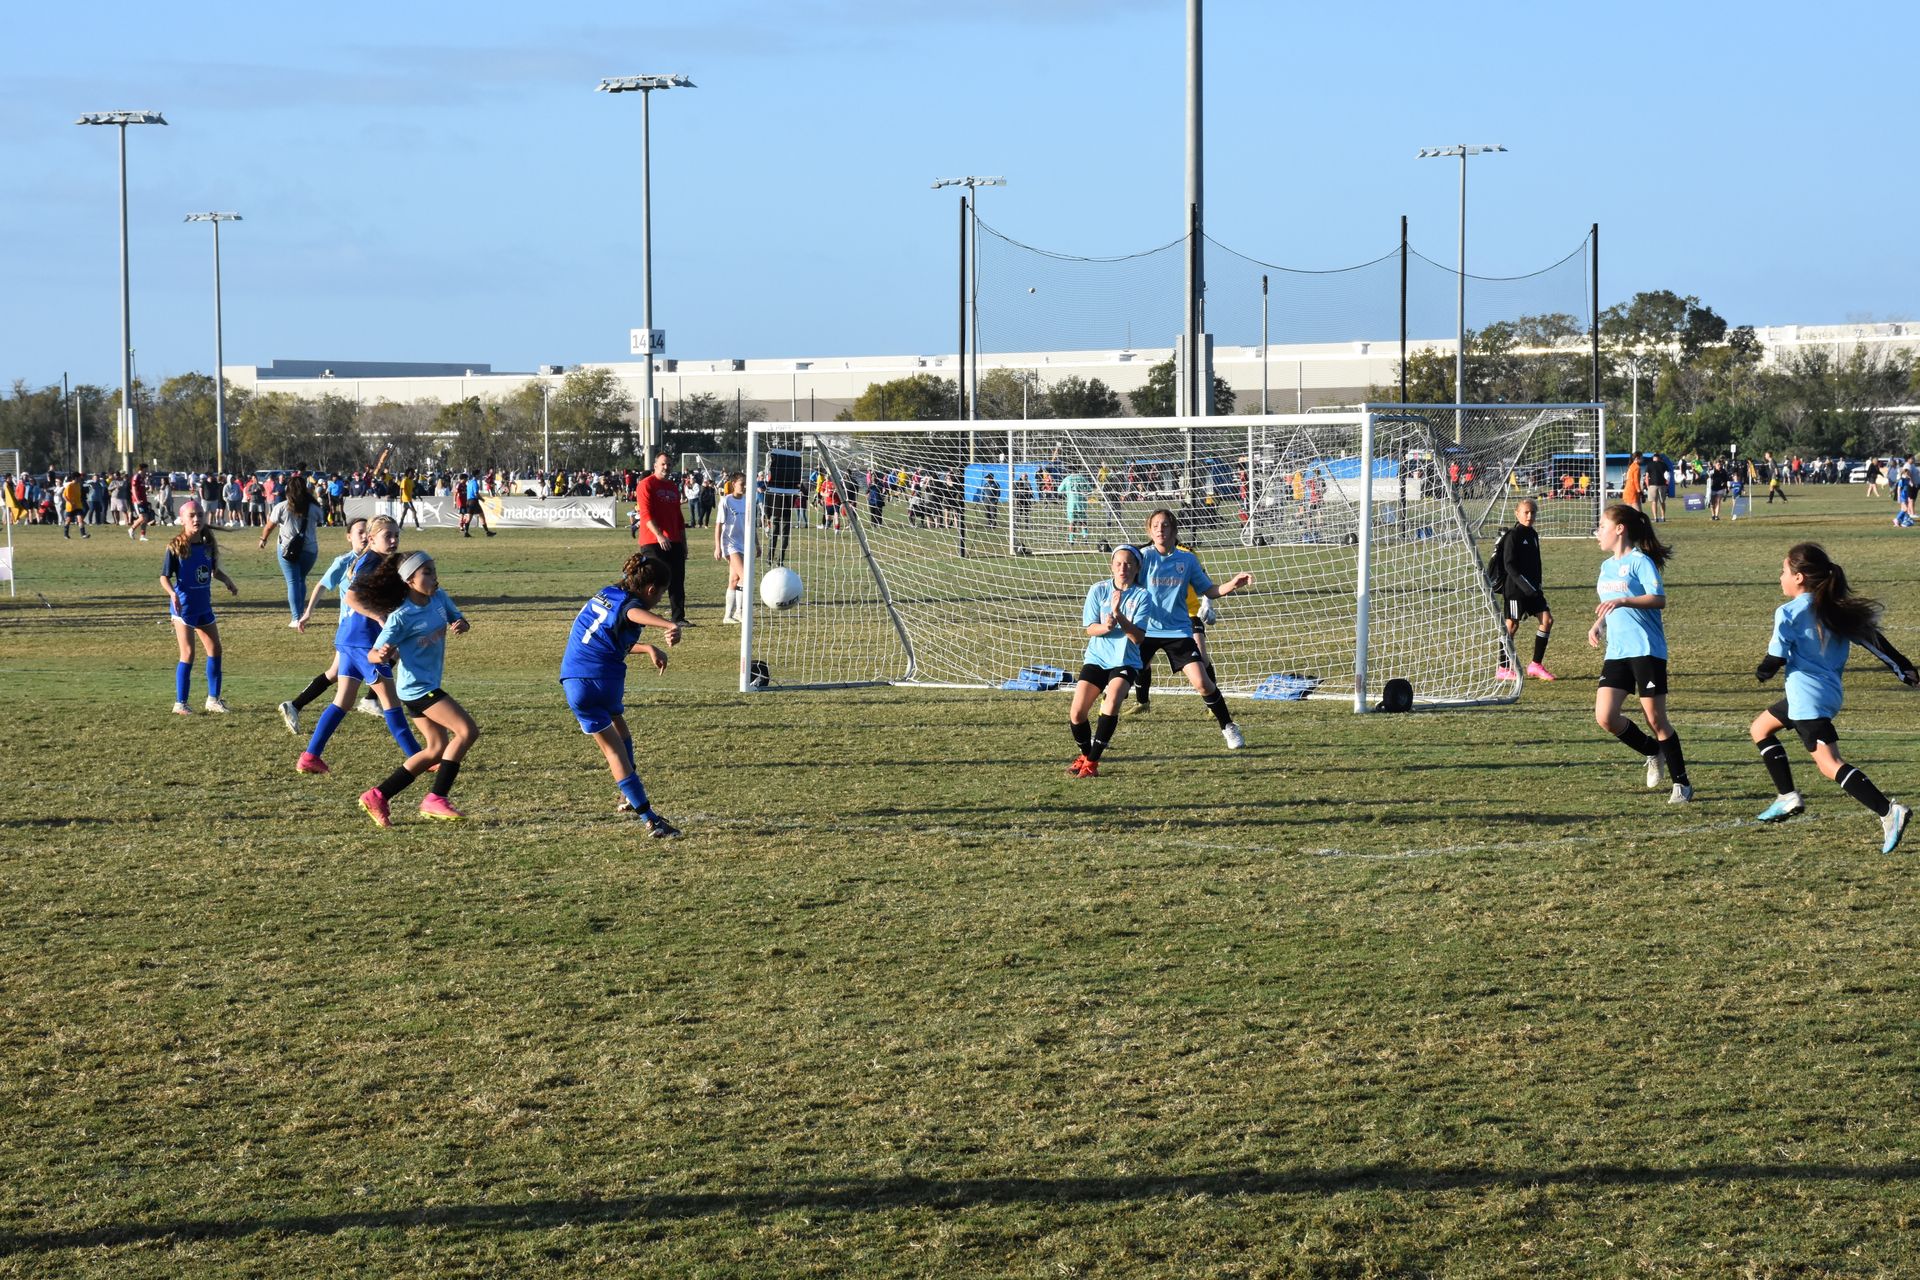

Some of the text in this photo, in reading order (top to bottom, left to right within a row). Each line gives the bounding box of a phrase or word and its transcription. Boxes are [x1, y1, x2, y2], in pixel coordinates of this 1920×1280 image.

[632, 334, 647, 349] 14
[649, 333, 665, 349] 14
[503, 504, 614, 523] markasports.com
